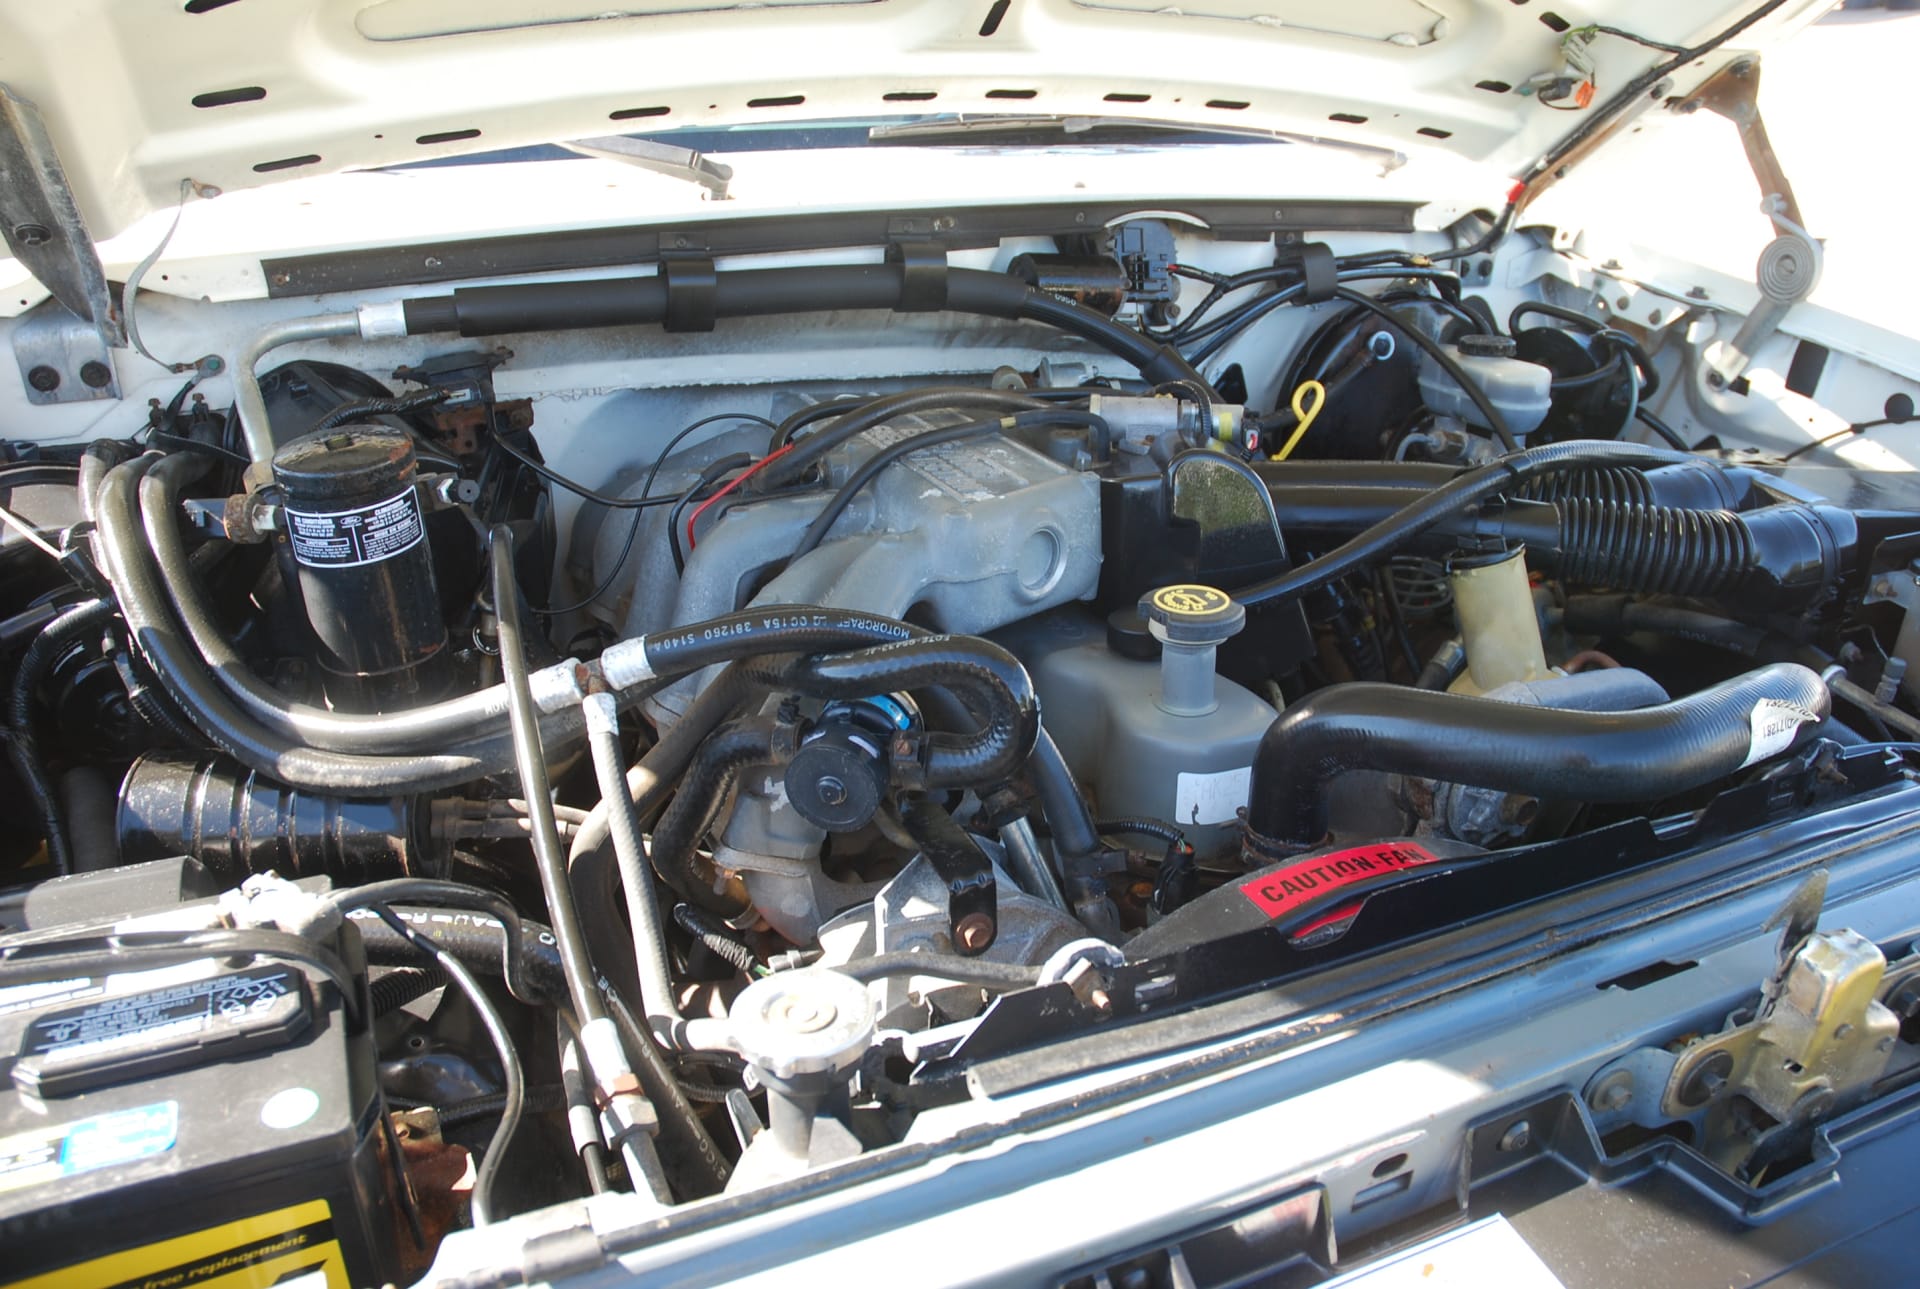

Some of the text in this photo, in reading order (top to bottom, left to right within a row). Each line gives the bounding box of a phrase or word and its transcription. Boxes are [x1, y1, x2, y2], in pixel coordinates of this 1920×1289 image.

[704, 621, 751, 640] 381260
[836, 616, 911, 639] MOTORCRAFT
[188, 1233, 308, 1279] replacement
